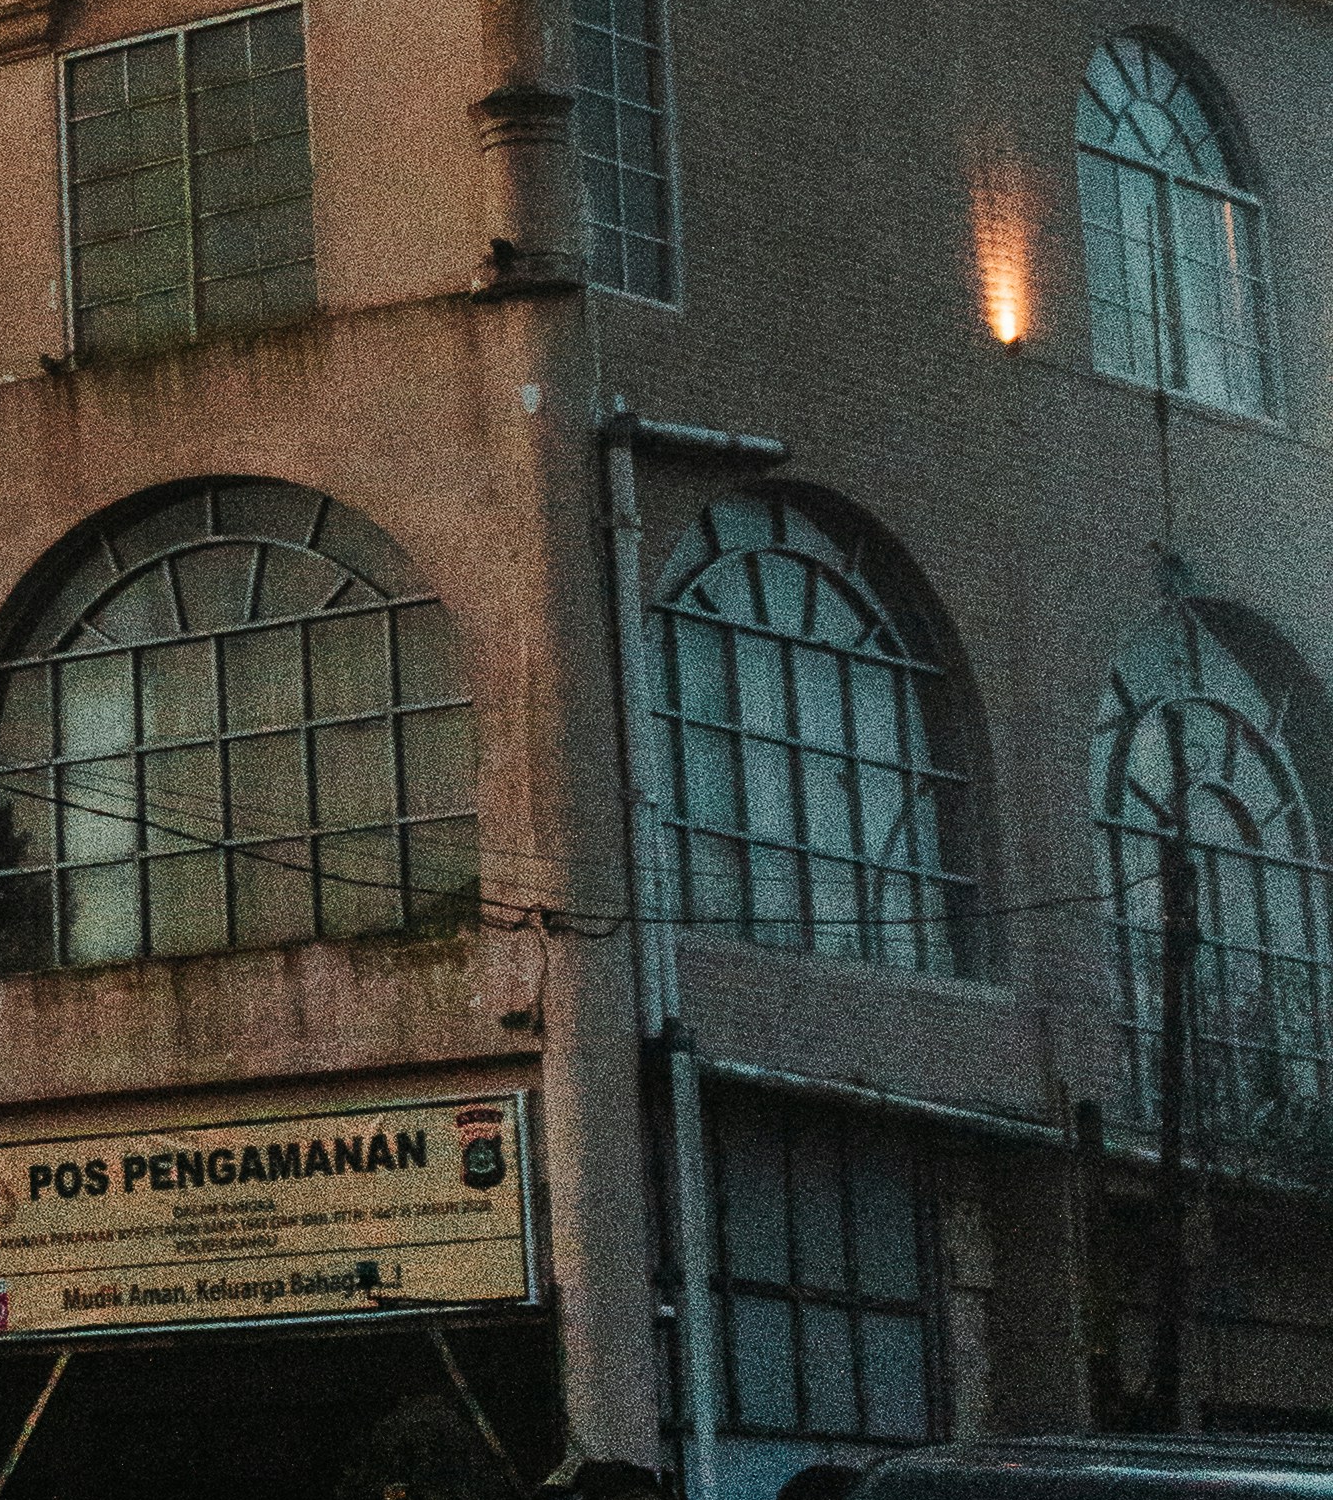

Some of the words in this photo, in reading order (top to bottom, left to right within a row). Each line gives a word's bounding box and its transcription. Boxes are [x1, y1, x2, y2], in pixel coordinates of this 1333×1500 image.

[29, 1158, 111, 1202] POS
[123, 1129, 429, 1194] PENGAMANAN
[63, 1286, 123, 1311] Mudik
[195, 1274, 286, 1304] Keluarga
